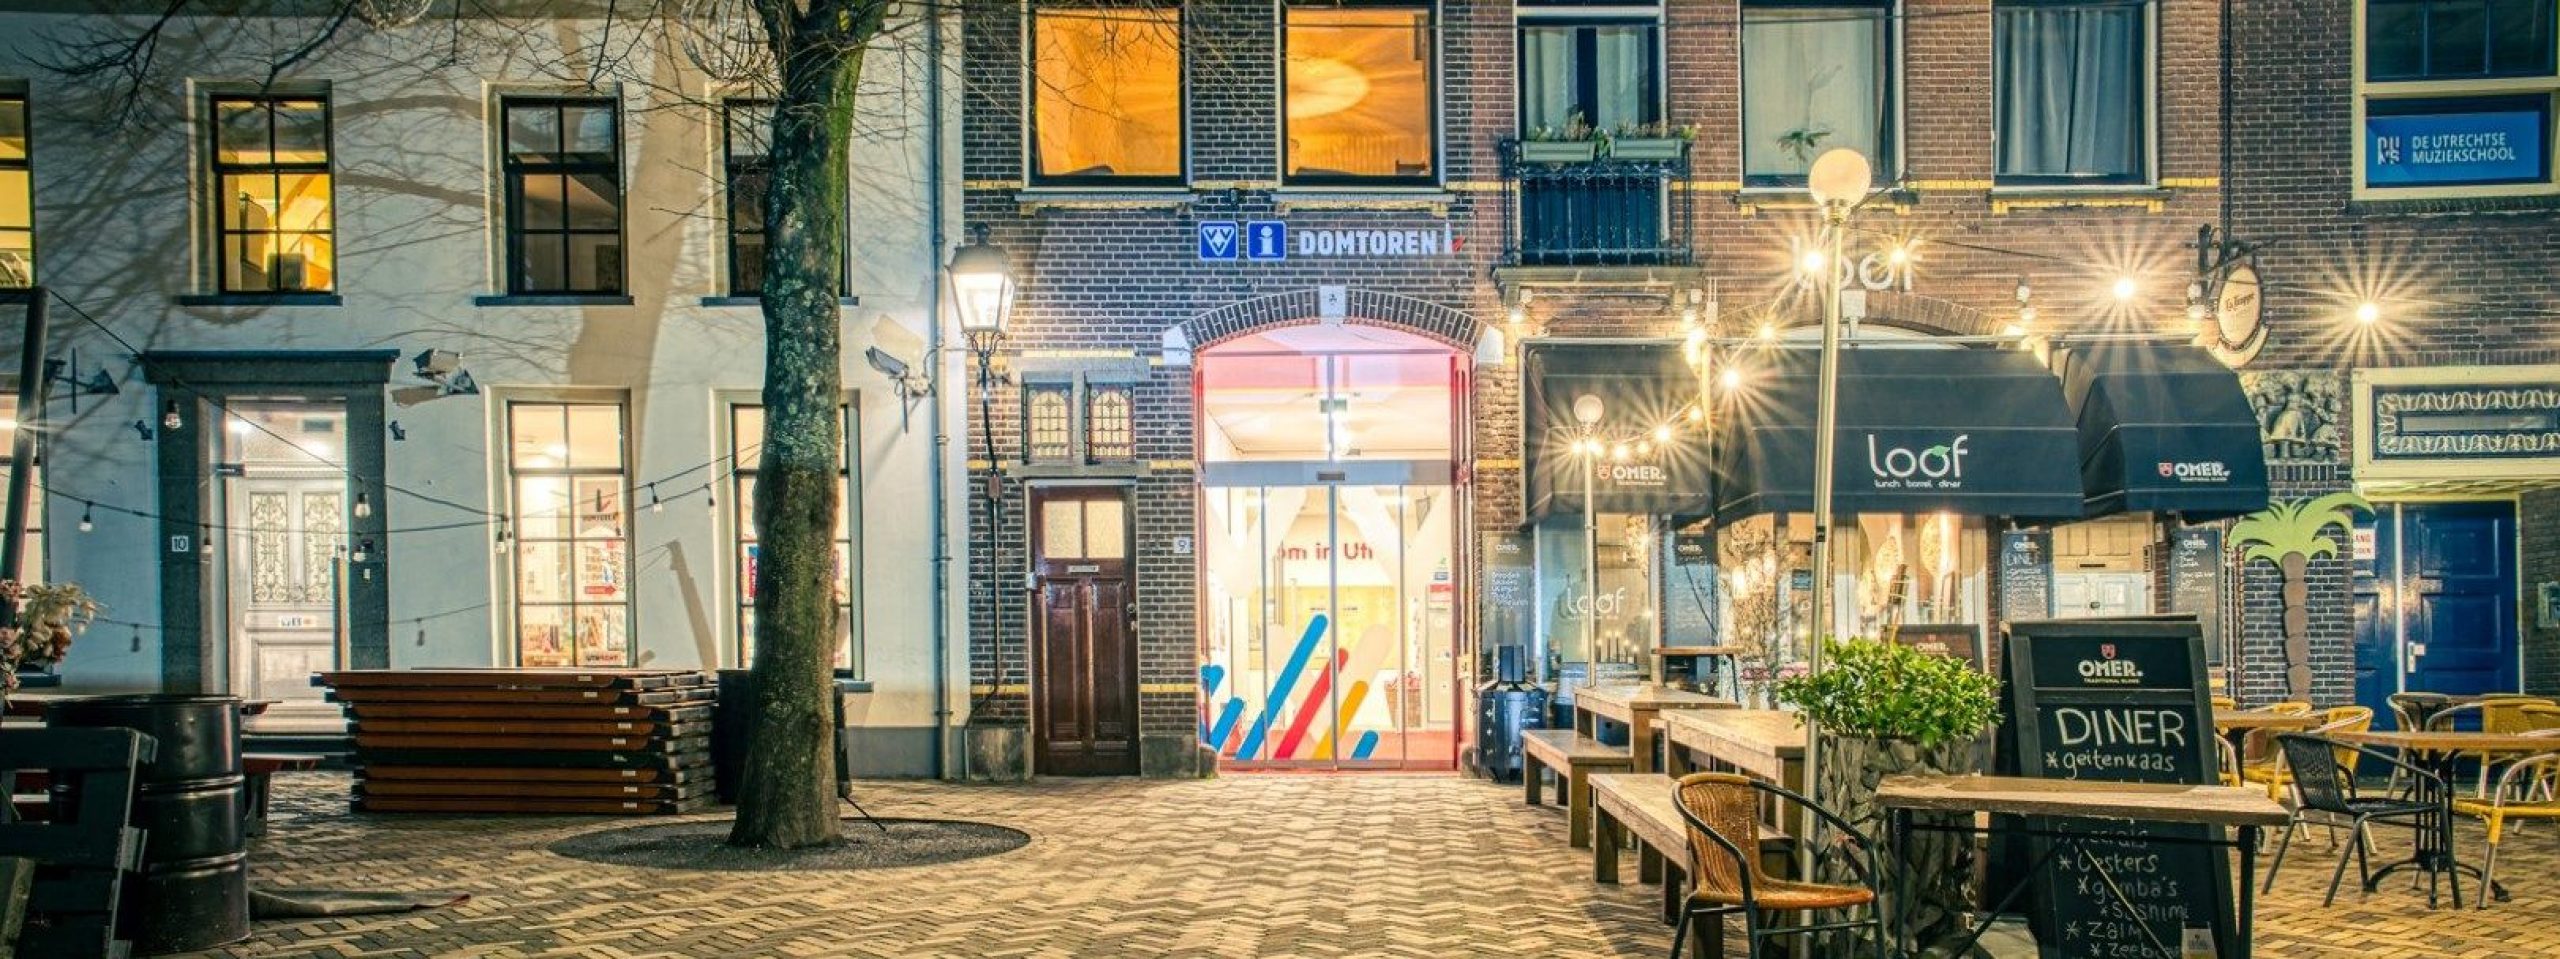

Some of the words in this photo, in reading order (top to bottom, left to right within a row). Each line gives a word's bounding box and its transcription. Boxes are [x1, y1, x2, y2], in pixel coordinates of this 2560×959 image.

[2412, 136, 2429, 149] DE
[2433, 132, 2506, 148] UTRECHTSE
[2412, 147, 2516, 164] MUZIEKSCHOOL
[1300, 230, 1437, 255] DOMTOREN
[1868, 434, 1968, 478] loof
[173, 538, 187, 551] 10
[1178, 539, 1187, 551] 9
[2078, 660, 2144, 677] OMER.
[2056, 708, 2185, 747] DINER
